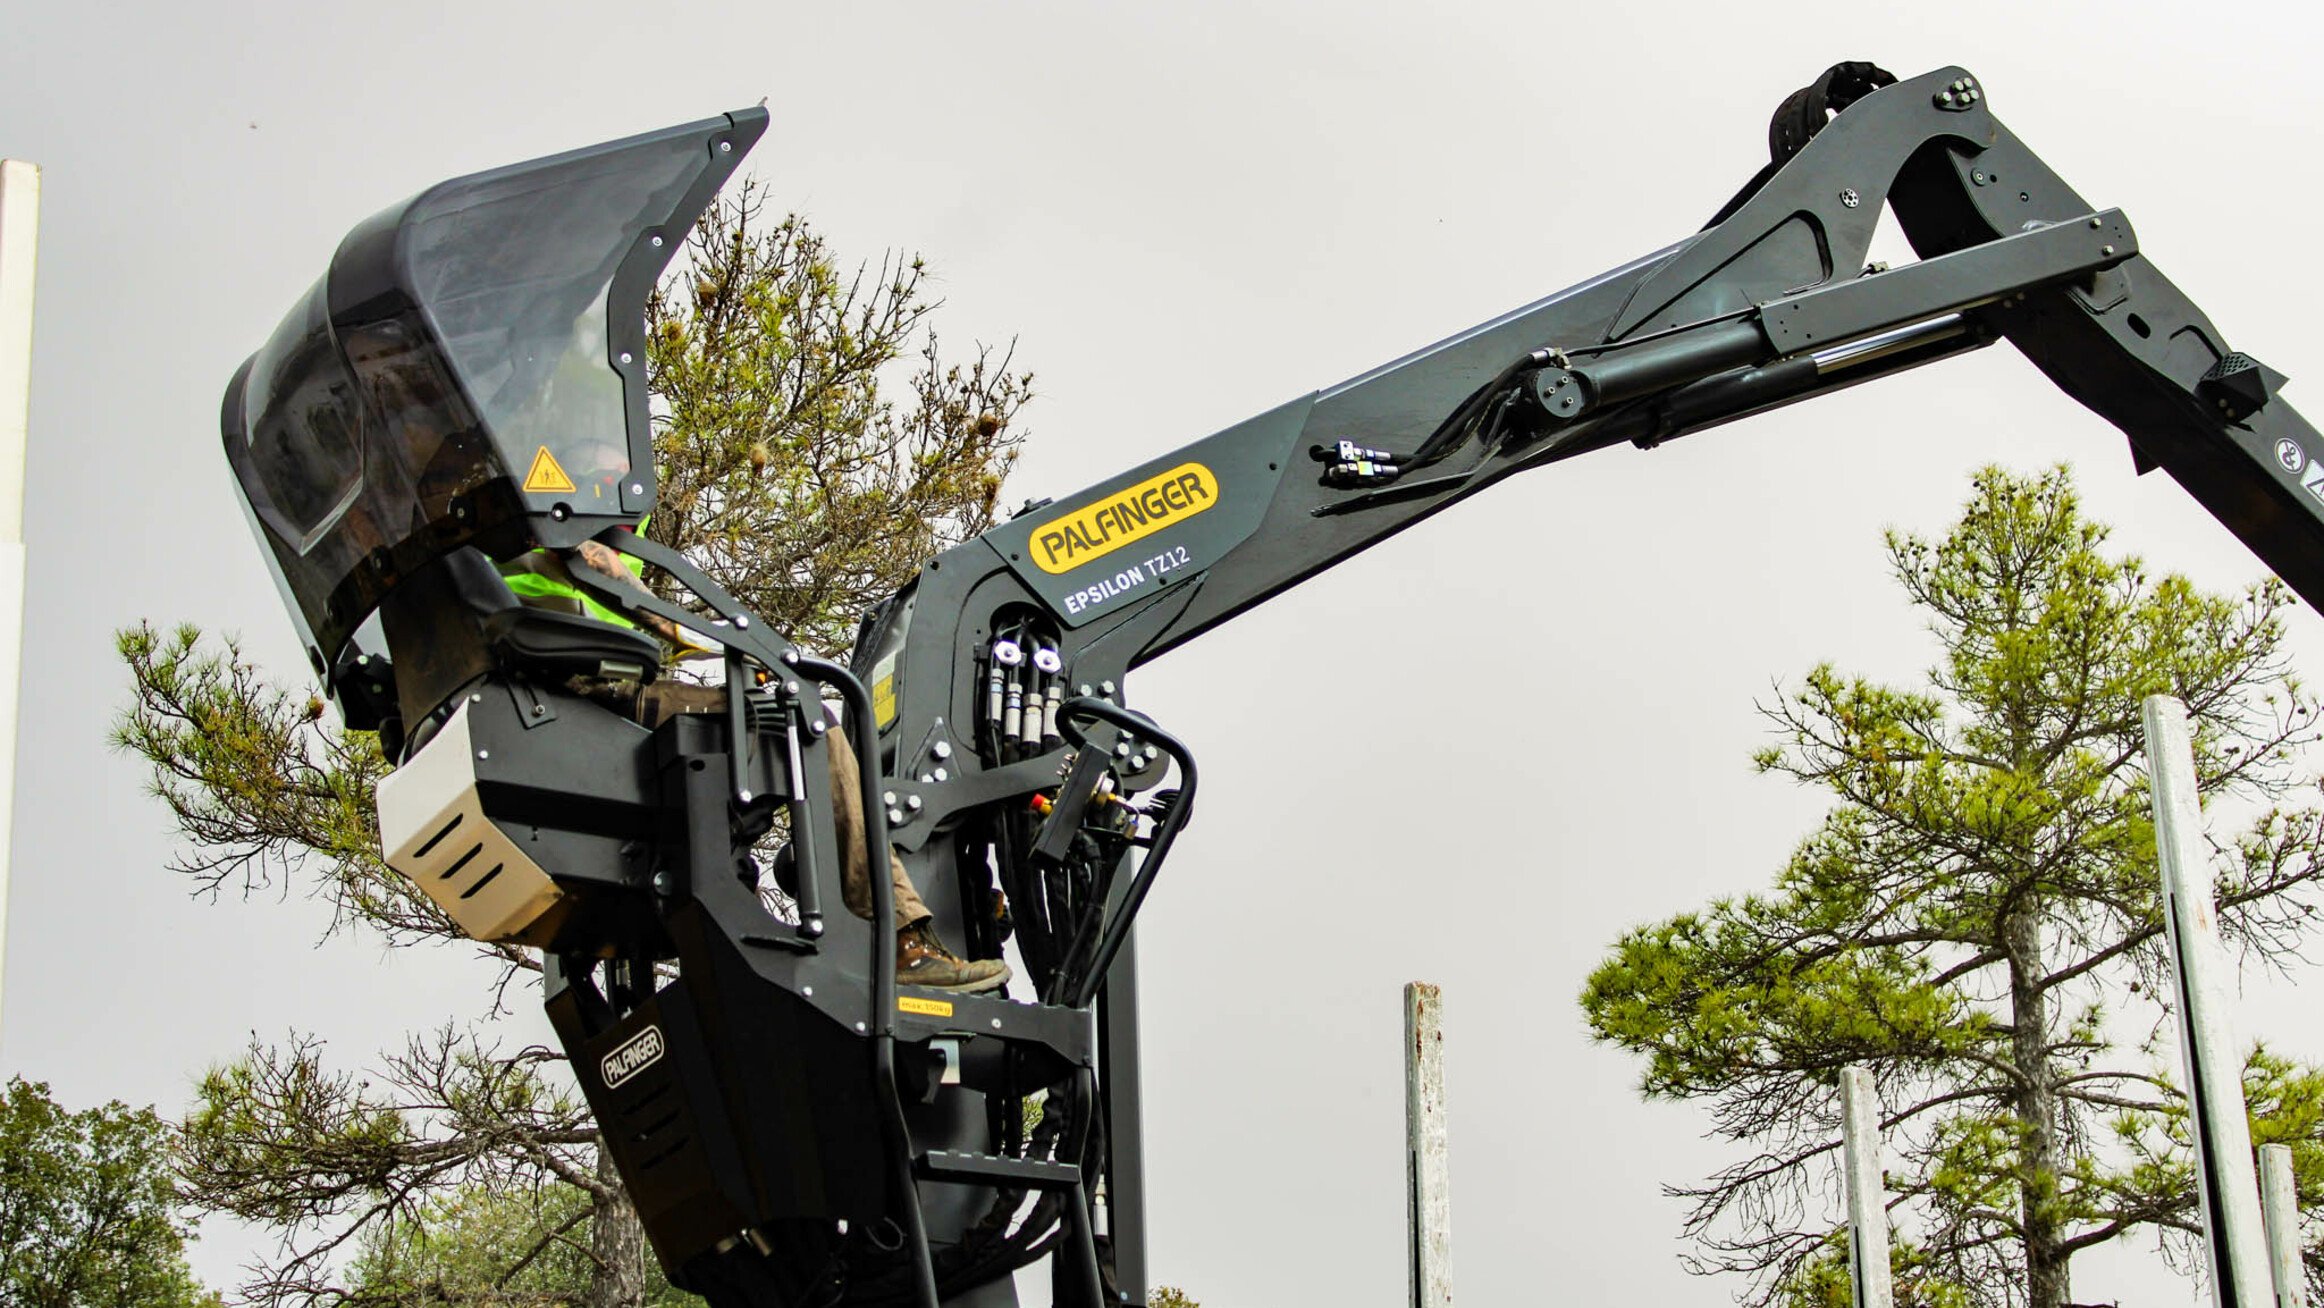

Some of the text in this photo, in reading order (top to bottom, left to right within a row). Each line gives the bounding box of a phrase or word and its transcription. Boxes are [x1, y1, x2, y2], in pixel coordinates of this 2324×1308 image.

[1040, 472, 1208, 565] PALFINGER
[1063, 546, 1190, 615] EPSILON TZ12
[604, 1032, 661, 1082] PALFINGER
